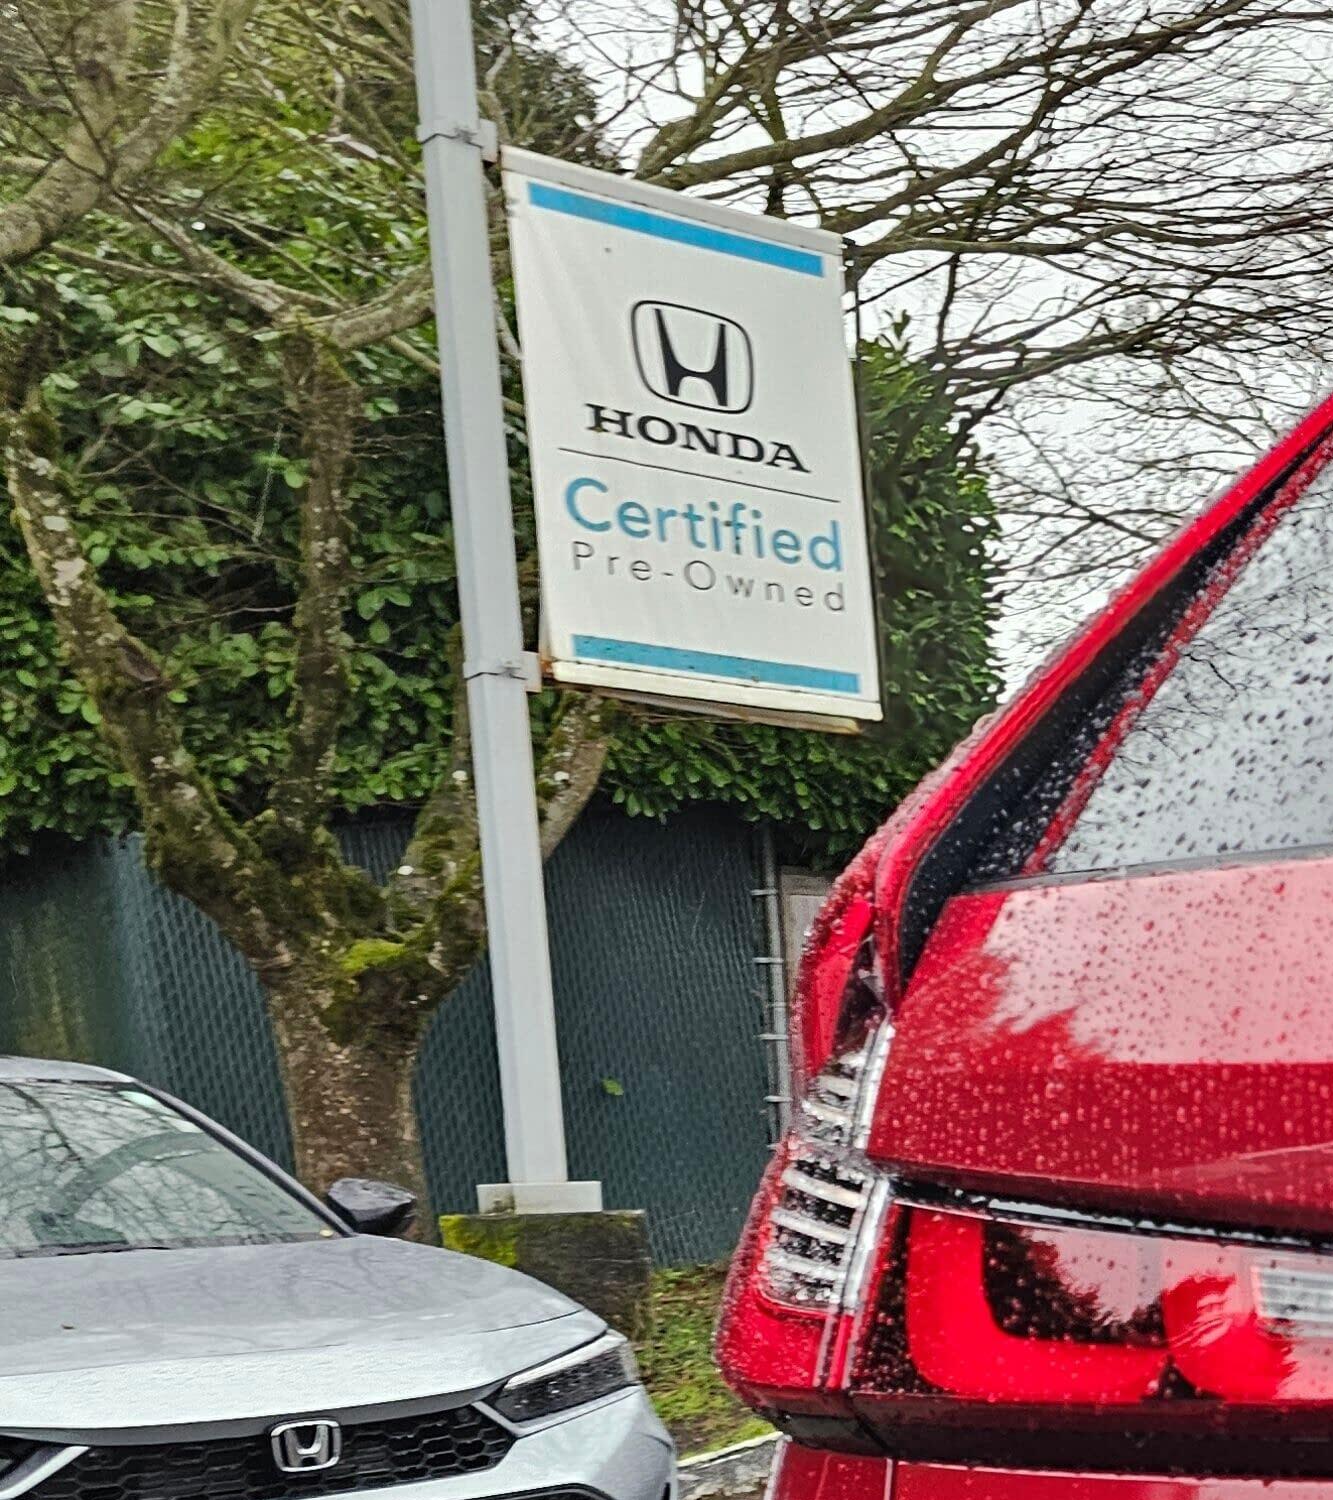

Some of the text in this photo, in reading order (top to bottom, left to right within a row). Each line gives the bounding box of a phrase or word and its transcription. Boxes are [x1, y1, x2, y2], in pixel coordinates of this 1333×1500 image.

[586, 403, 812, 474] HONDA
[564, 476, 844, 572] Certified
[571, 540, 846, 613] Pre-Owned
